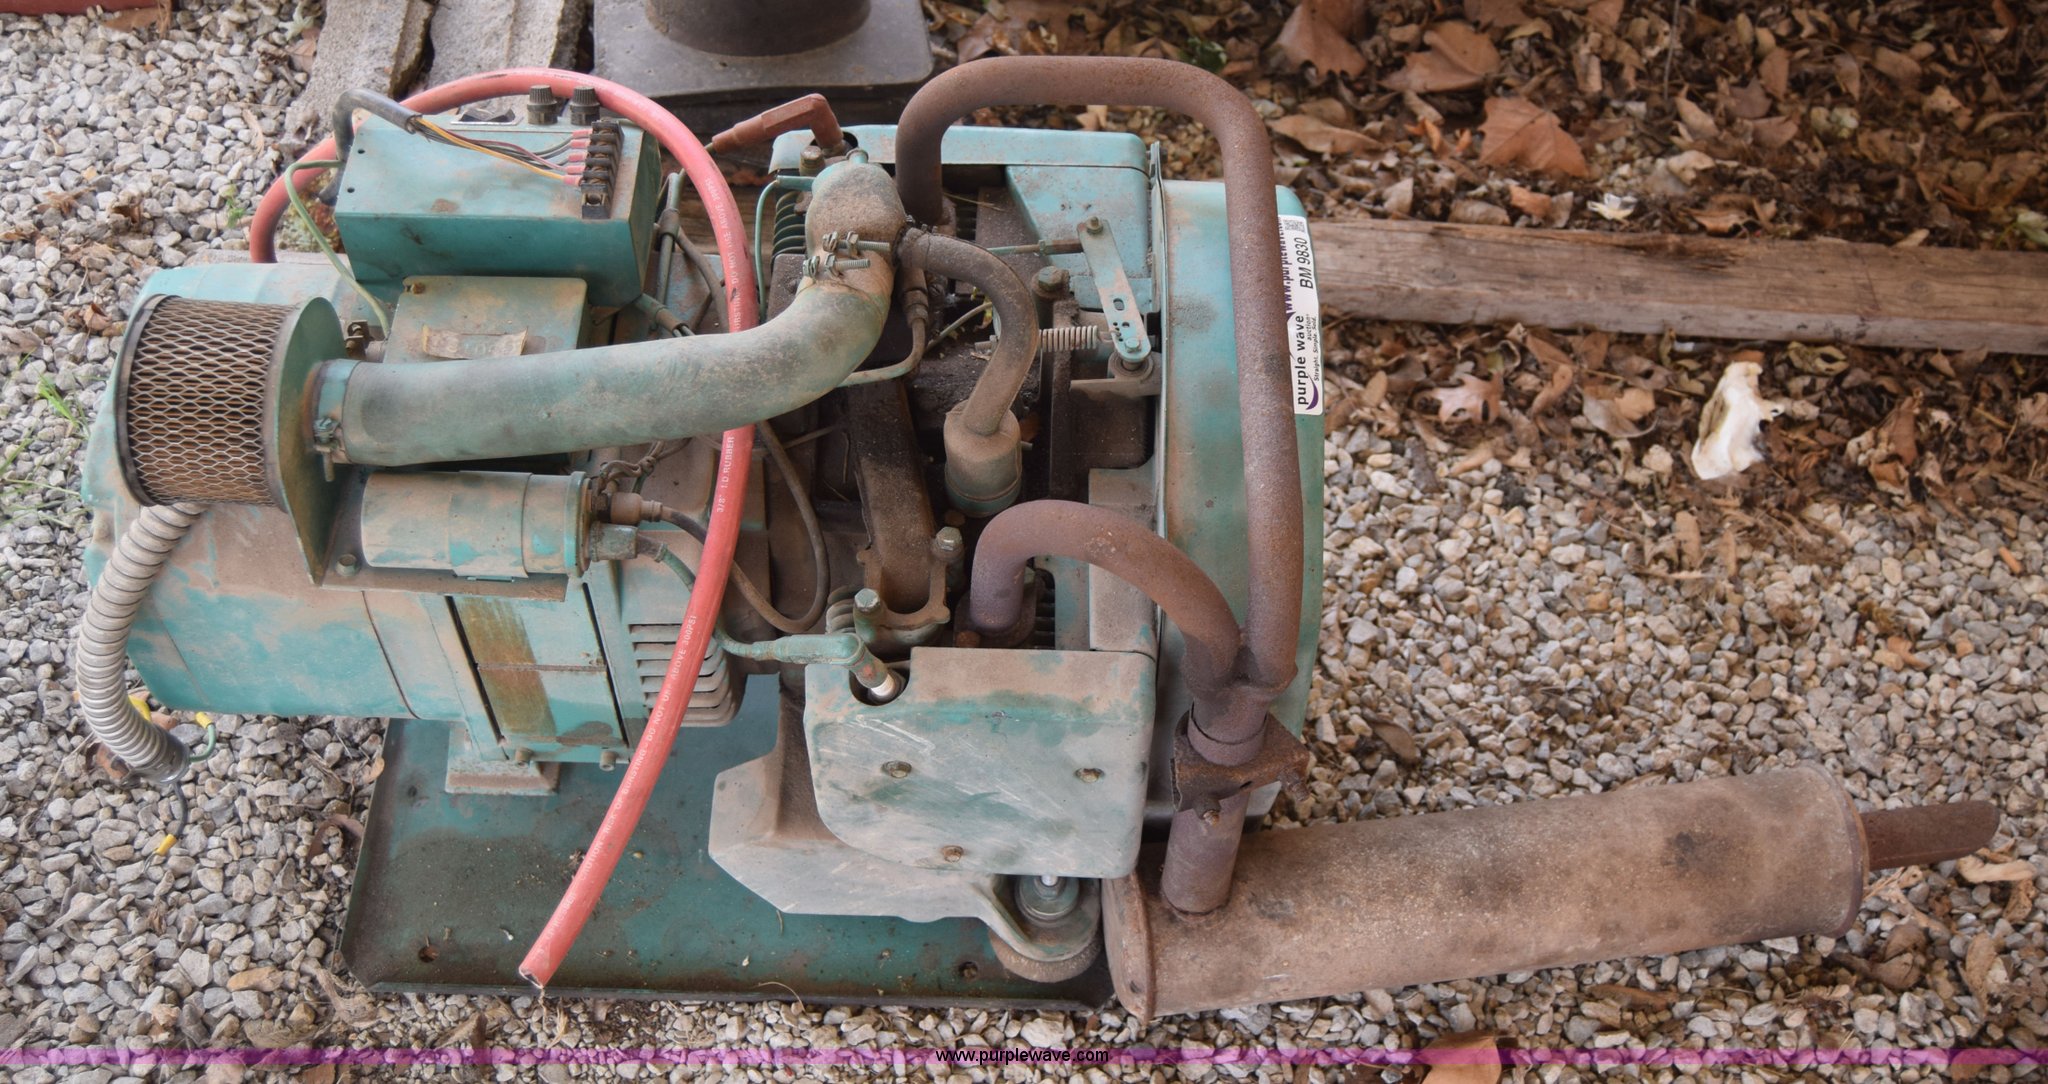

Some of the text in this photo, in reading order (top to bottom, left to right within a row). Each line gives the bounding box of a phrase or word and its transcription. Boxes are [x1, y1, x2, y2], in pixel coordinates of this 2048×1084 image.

[1294, 238, 1314, 290] BM 9830
[1295, 316, 1309, 405] purple wave
[652, 704, 665, 725] NOT
[670, 648, 686, 680] ABOVE
